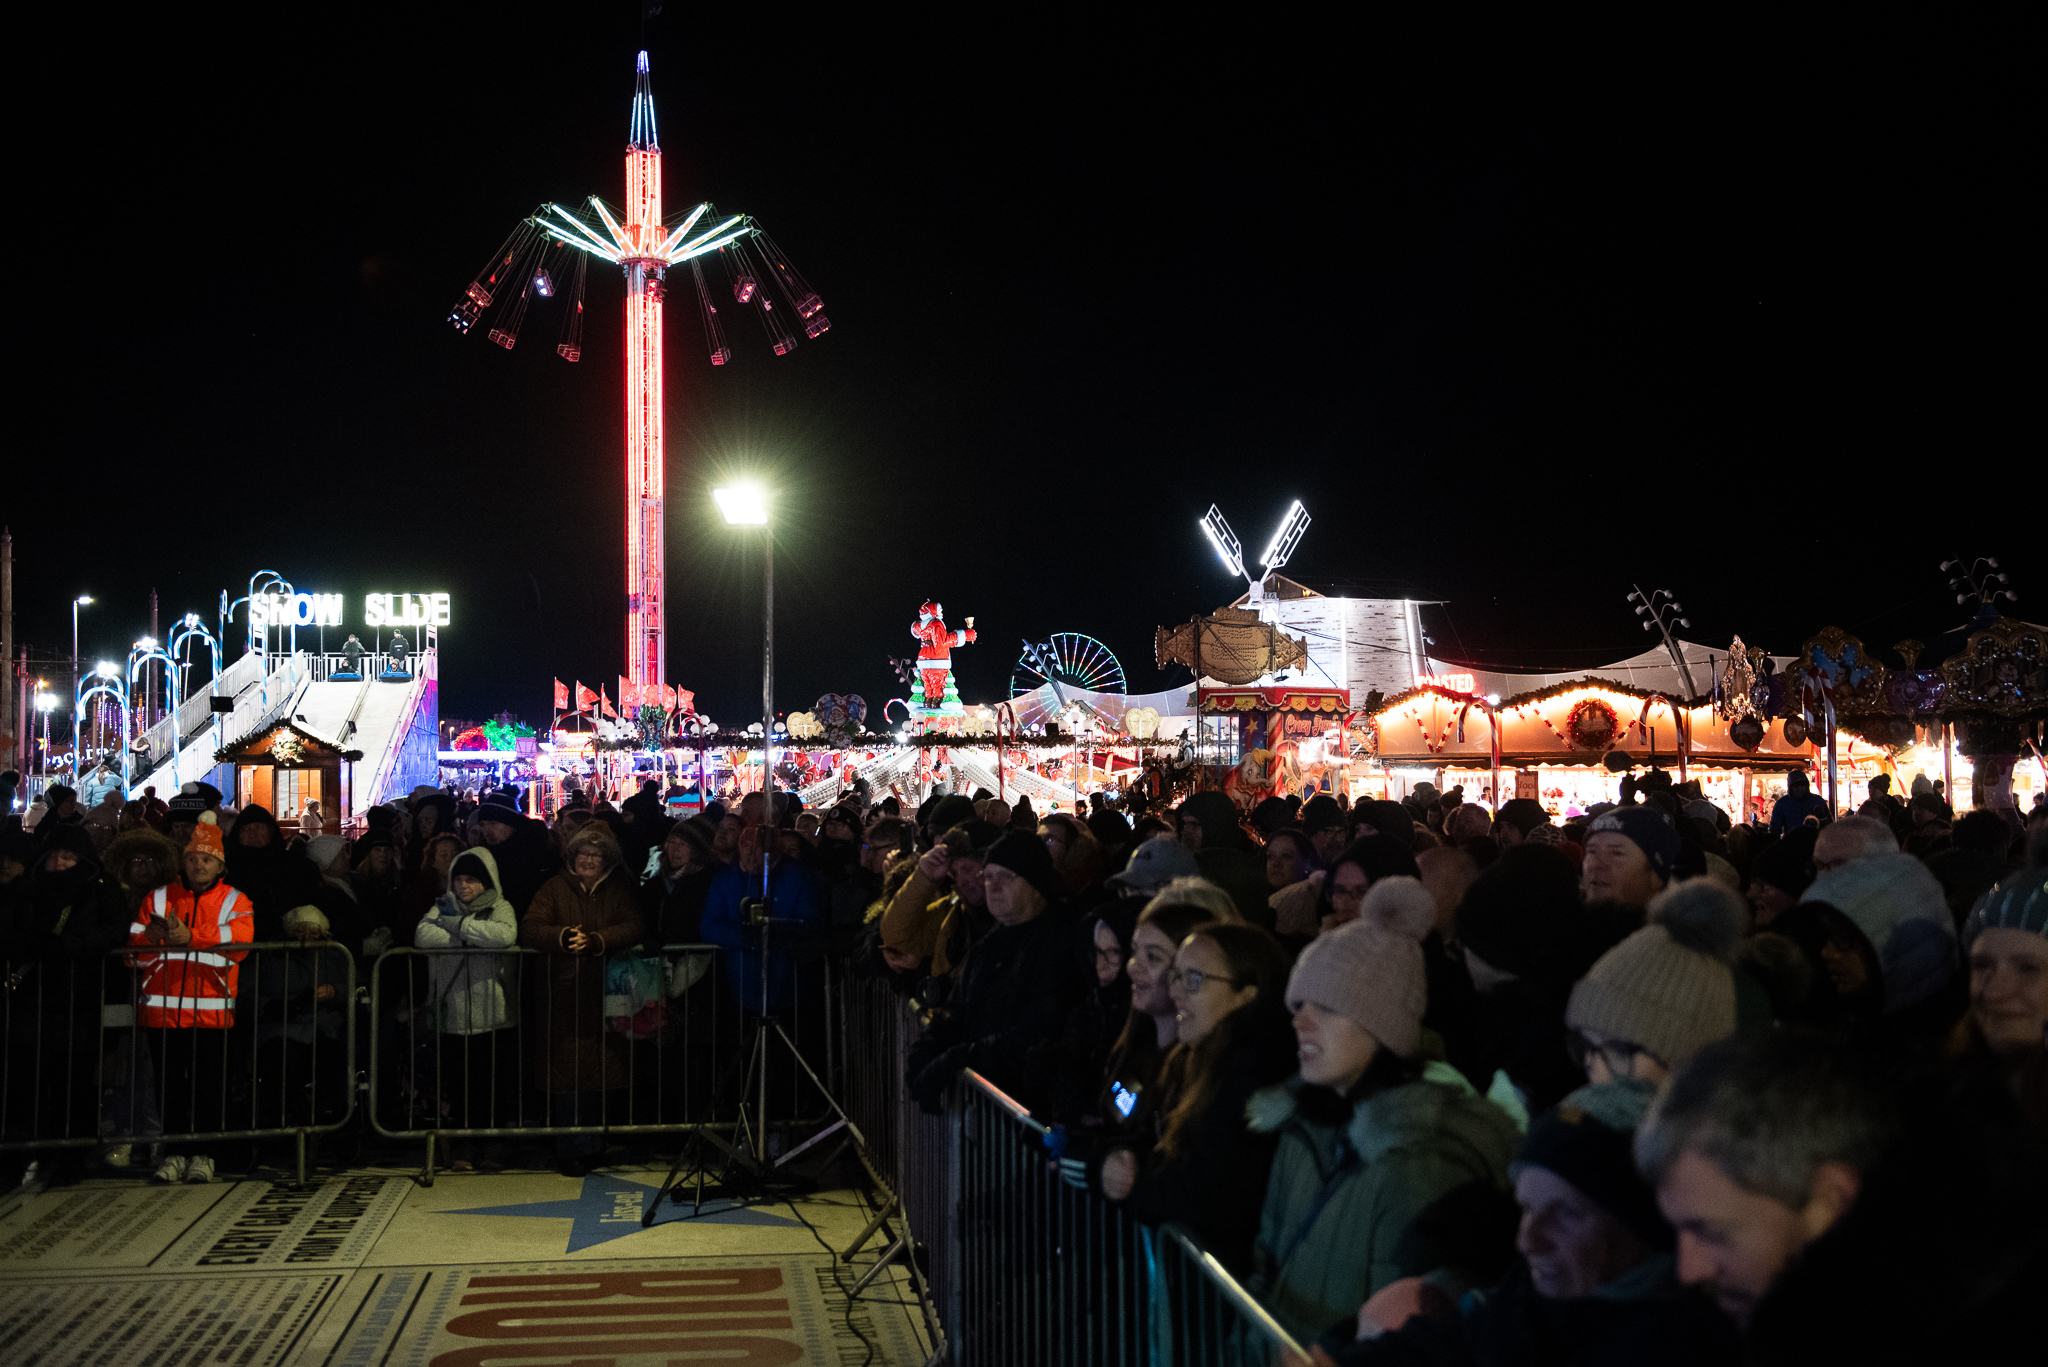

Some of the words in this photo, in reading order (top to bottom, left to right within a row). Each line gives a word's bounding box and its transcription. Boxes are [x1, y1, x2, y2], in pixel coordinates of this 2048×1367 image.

[250, 592, 343, 626] SNOW
[365, 592, 450, 626] SLIDE
[1416, 674, 1475, 693] TOASTED
[1285, 714, 1312, 737] Crazy
[234, 1207, 303, 1227] GAG
[306, 1219, 358, 1236] THE
[195, 1229, 283, 1265] EVERY
[284, 1237, 345, 1263] FROM
